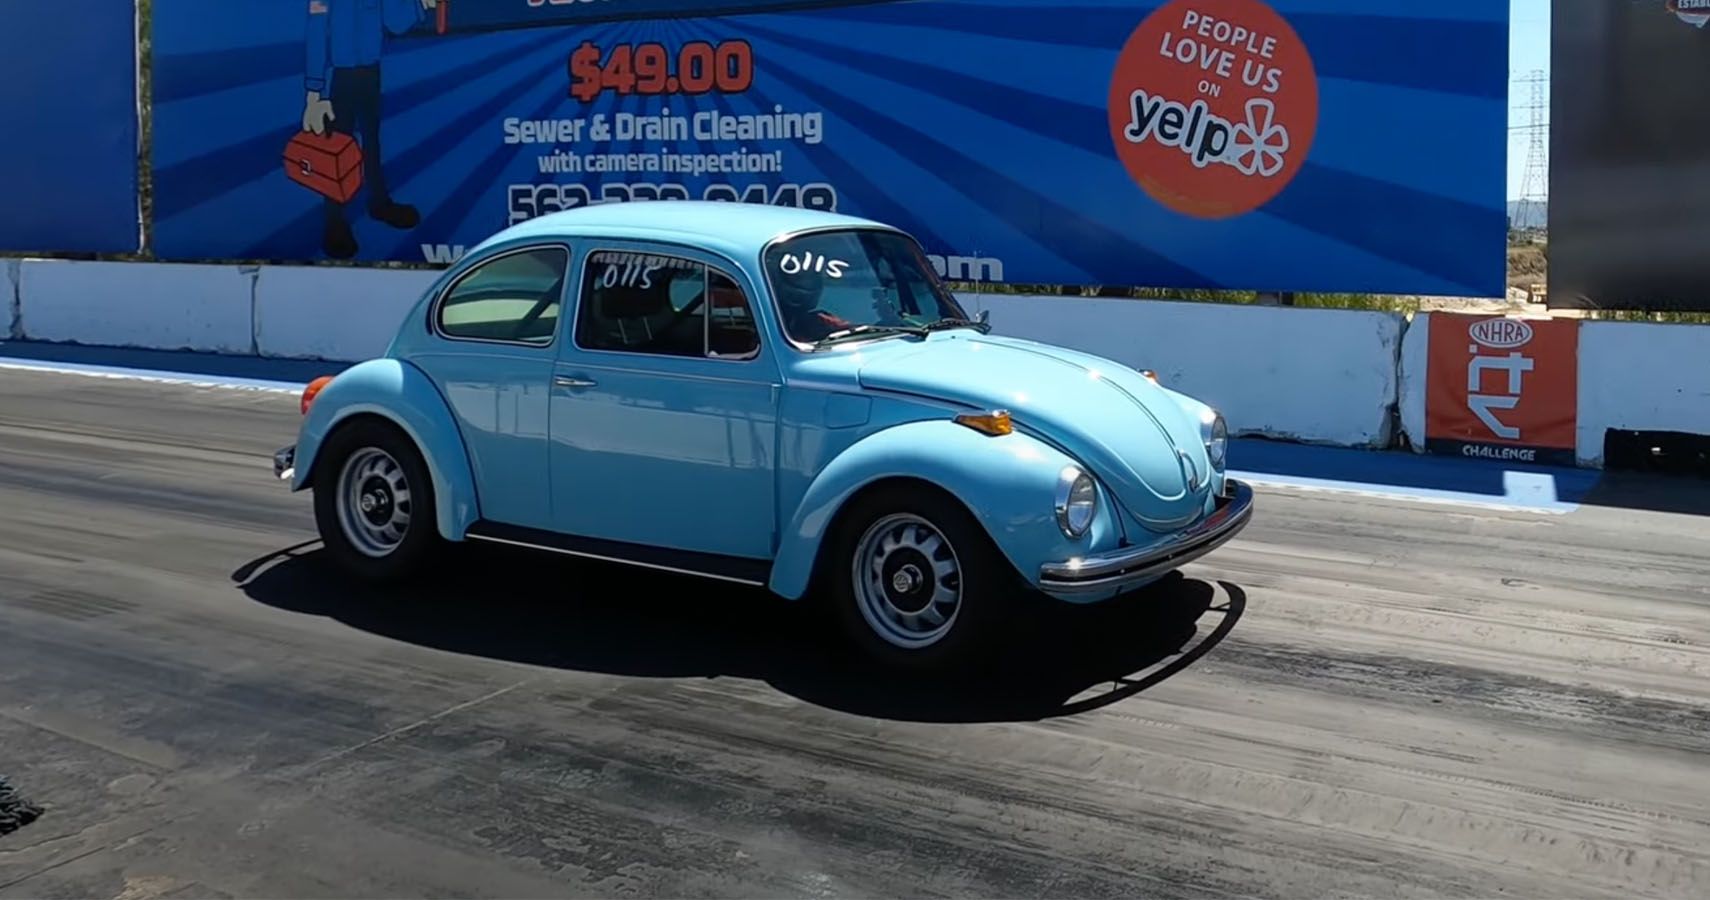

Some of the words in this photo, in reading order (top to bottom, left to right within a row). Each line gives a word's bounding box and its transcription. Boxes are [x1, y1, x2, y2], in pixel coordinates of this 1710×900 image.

[1182, 10, 1278, 59] PEOPLE
[570, 41, 753, 101] $49.00
[1159, 32, 1236, 78] LOVE
[1242, 59, 1283, 93] US
[1198, 79, 1221, 97] ON
[503, 117, 585, 144] Sewer
[590, 114, 611, 142] &
[615, 107, 688, 141] Drain
[692, 104, 824, 144] Cleaning
[1127, 92, 1231, 165] yelp
[538, 149, 582, 173] with
[584, 153, 660, 172] camera
[661, 147, 783, 176] inspection!
[602, 263, 655, 289] 0115
[780, 251, 850, 278] 0115
[1478, 321, 1524, 343] NHRA
[1462, 444, 1537, 461] CHALLENGE
